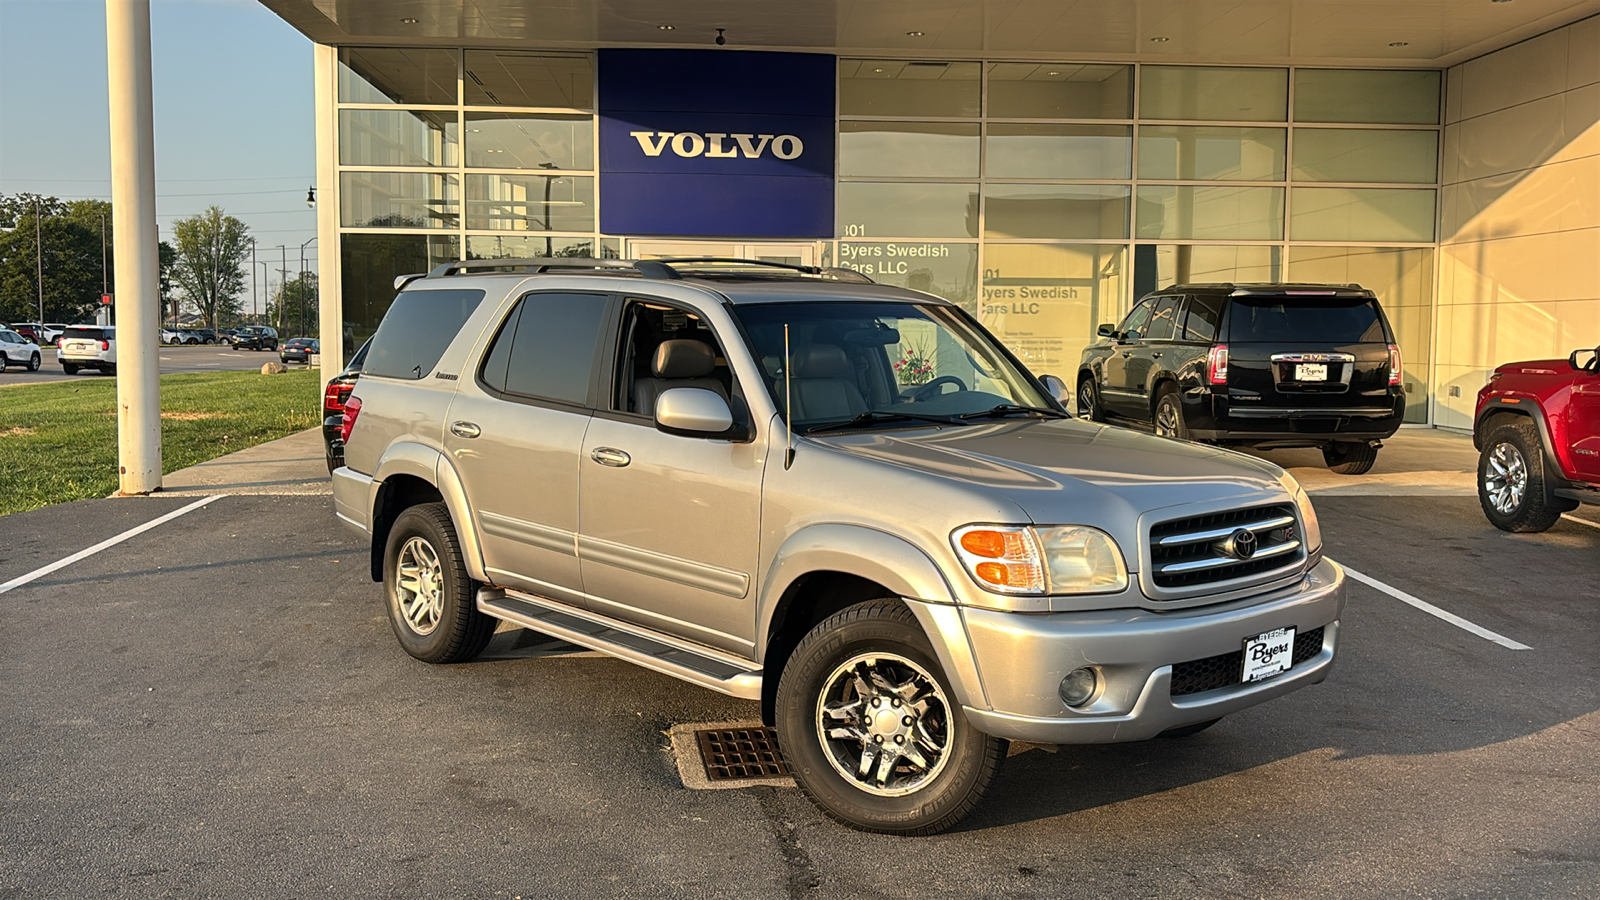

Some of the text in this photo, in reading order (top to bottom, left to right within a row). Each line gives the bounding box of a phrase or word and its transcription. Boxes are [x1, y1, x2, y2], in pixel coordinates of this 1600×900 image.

[629, 131, 804, 160] VOLVO
[841, 243, 949, 260] Byers Swedish
[878, 261, 908, 275] LLC
[983, 268, 1000, 279] 01
[1019, 286, 1078, 299] Swedish
[1012, 302, 1040, 315] LLC
[1248, 642, 1289, 664] Byers
[794, 638, 841, 695] MICHELIN
